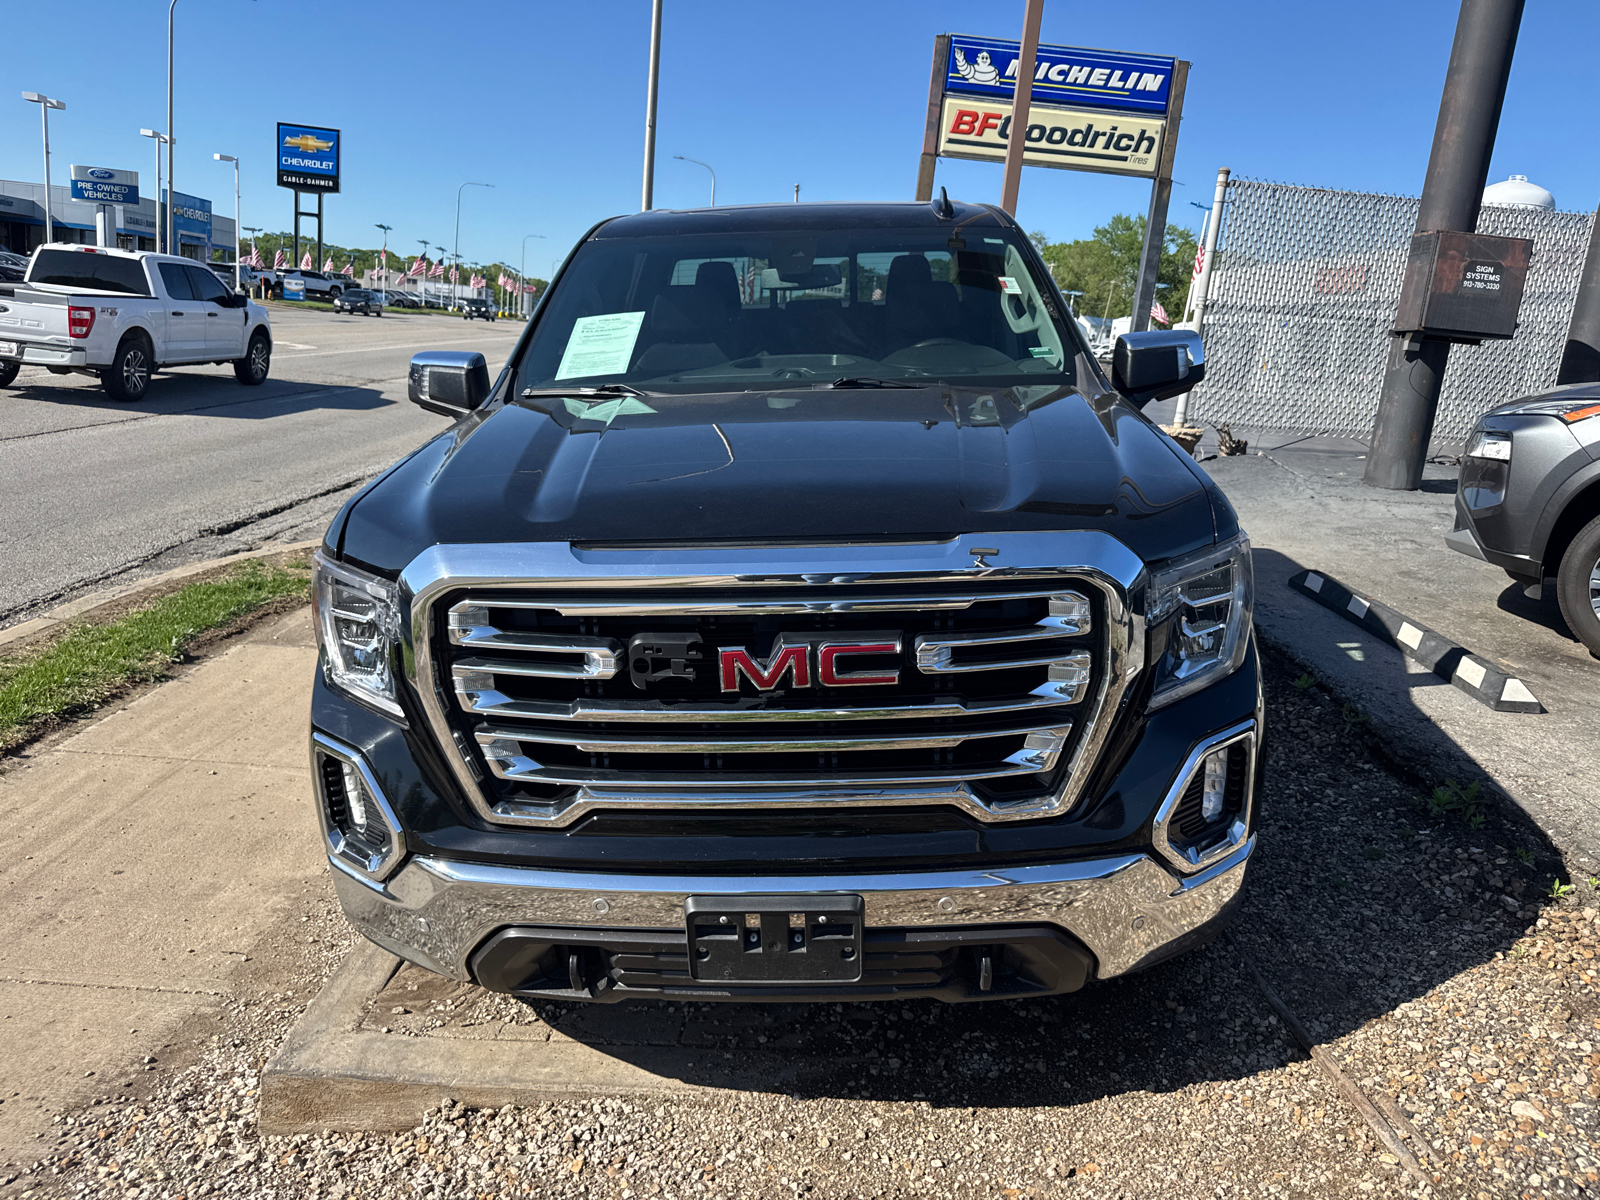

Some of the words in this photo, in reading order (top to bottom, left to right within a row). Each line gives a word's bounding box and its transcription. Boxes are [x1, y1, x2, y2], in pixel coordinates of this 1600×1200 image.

[282, 156, 334, 170] CHEVROLET
[1129, 154, 1149, 165] Tires
[93, 170, 110, 178] Ford
[83, 190, 124, 201] VEHICLES
[184, 207, 210, 222] CHEVROLET
[1475, 265, 1494, 273] SIGN
[1466, 272, 1500, 281] SYSTEMS
[718, 641, 901, 692] MC
